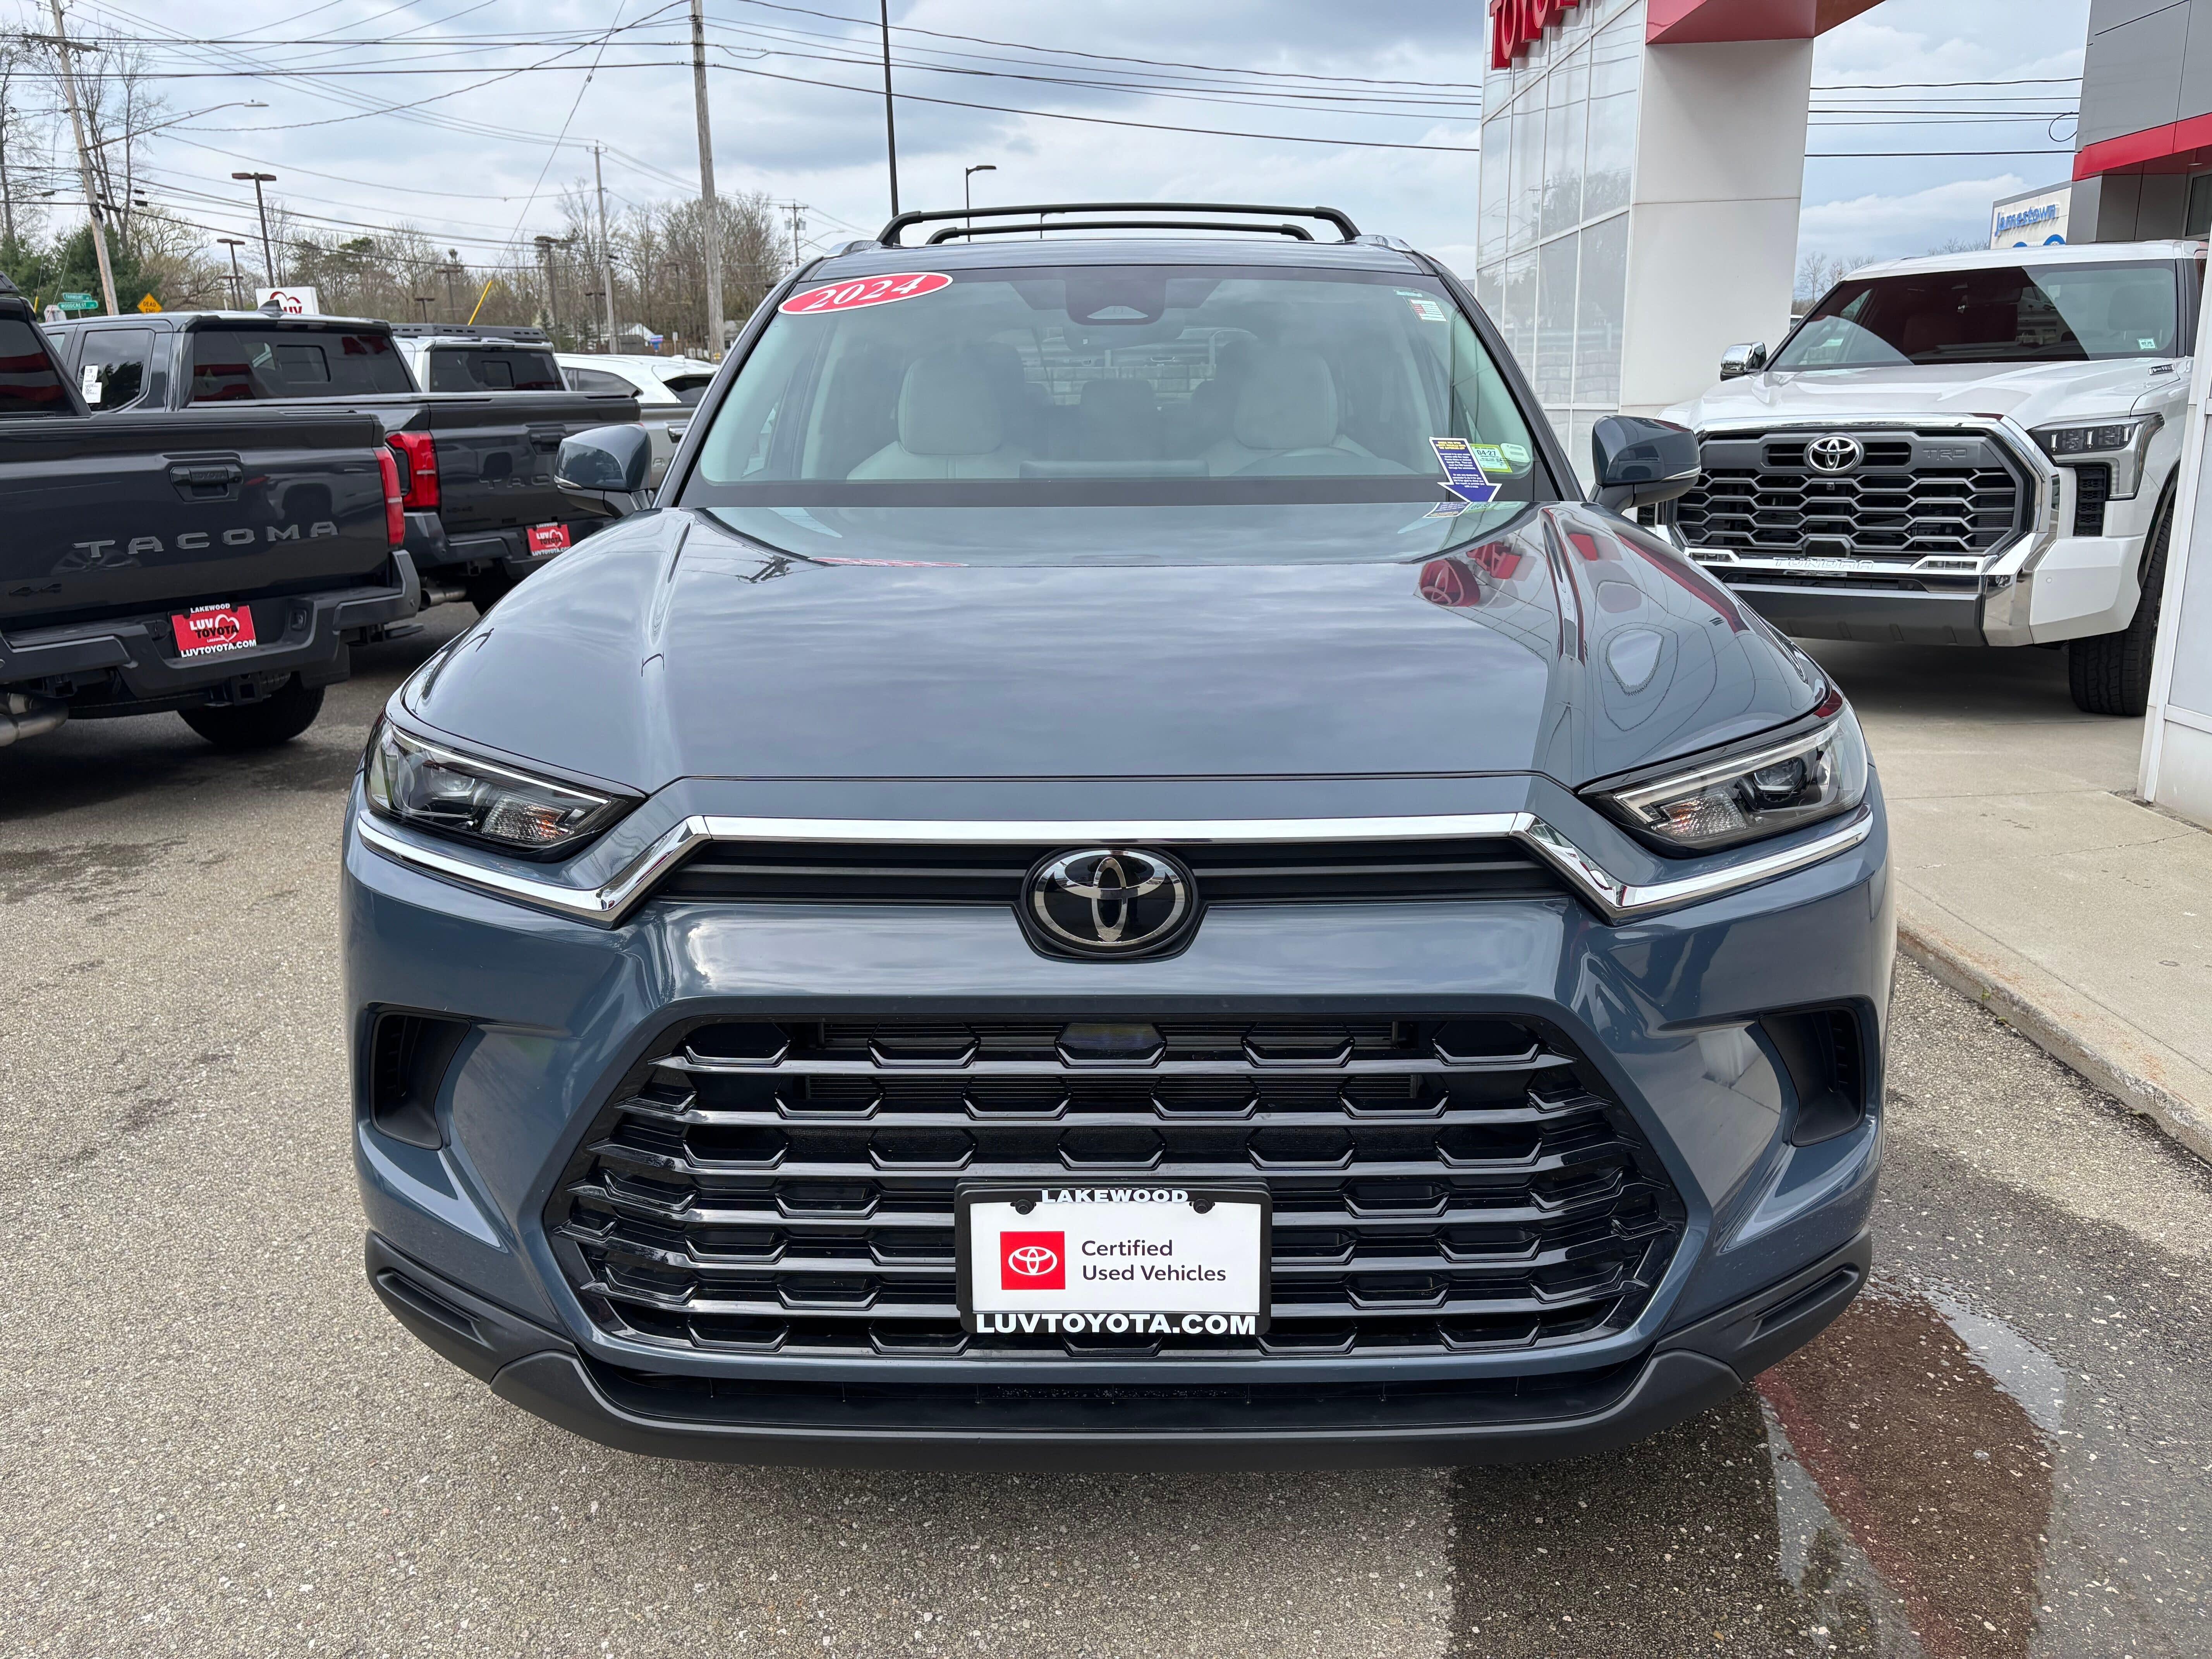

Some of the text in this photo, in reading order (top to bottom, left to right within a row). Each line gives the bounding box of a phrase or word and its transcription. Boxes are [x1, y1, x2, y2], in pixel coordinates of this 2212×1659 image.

[1995, 204, 2056, 237] Jamestown
[802, 275, 927, 311] 2024
[283, 306, 302, 314] UV
[1923, 448, 1967, 460] TRD
[479, 474, 551, 489] TAC
[73, 521, 338, 558] TACOMA
[1773, 557, 1874, 569] TUNDRA
[190, 603, 230, 613] LAKEWOOD
[189, 618, 213, 630] LUV
[195, 625, 239, 639] TOYOTA
[180, 639, 257, 658] LUVTOYOTA.COM
[1041, 1189, 1189, 1204] LAKEWOOD
[1082, 1239, 1173, 1257] Certified
[1082, 1264, 1226, 1281] Used Vehicles
[976, 1314, 1256, 1336] LUVTOYOTA.COM
